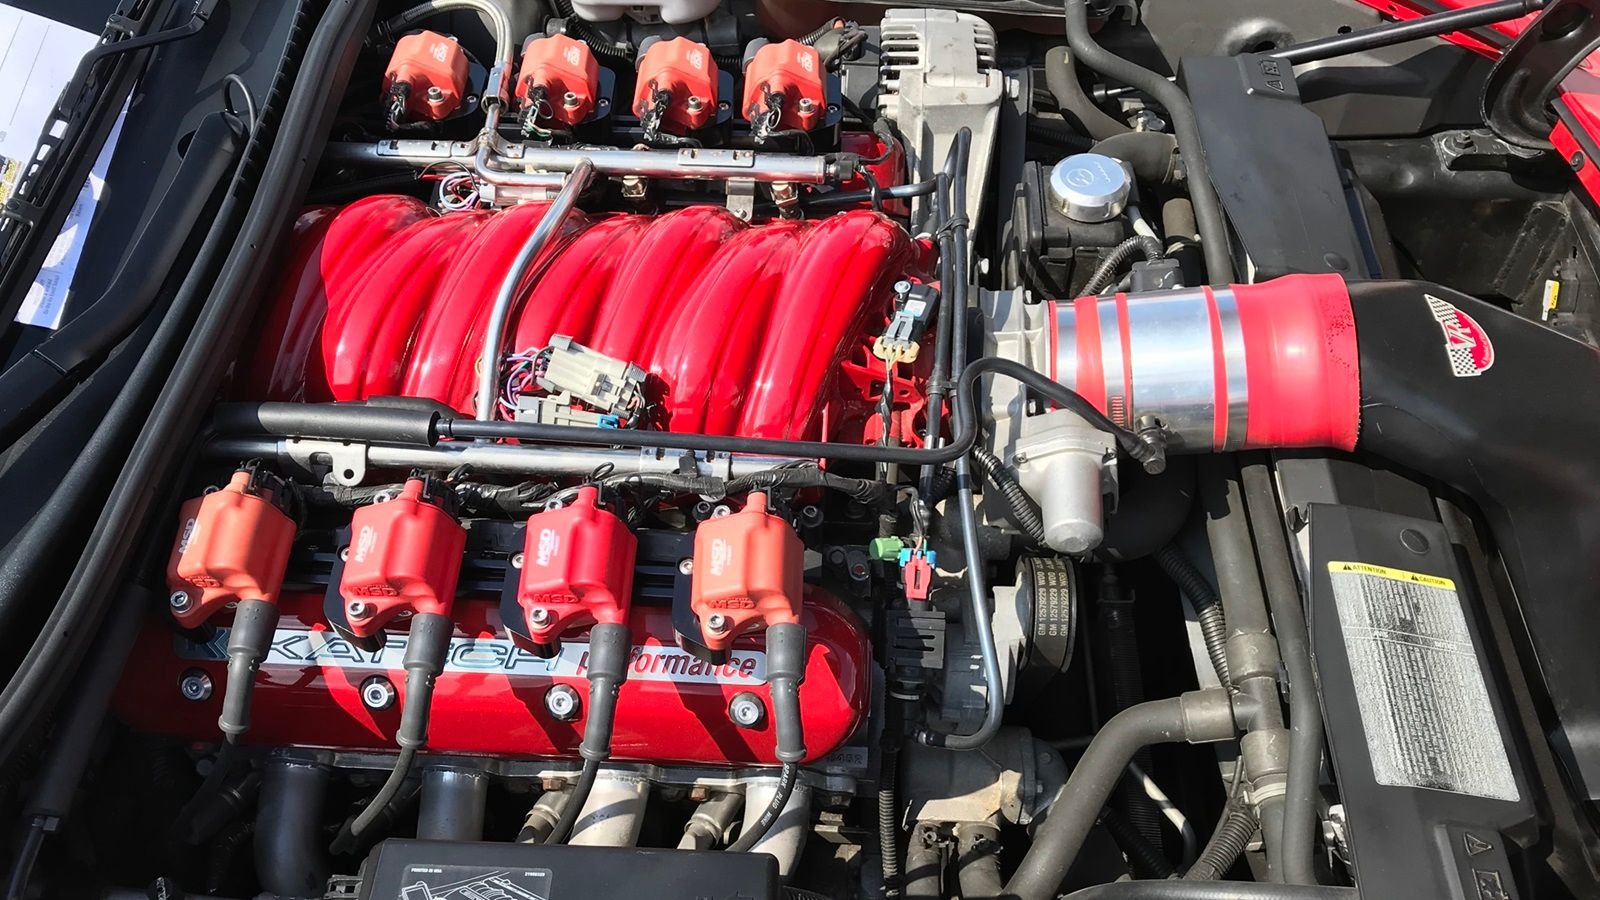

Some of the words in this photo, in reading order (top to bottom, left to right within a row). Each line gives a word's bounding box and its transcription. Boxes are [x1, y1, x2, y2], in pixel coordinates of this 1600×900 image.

[179, 518, 196, 553] MSD
[354, 525, 371, 563] MSD
[536, 528, 552, 566] MSD
[710, 538, 723, 576] MSD
[1352, 564, 1387, 575] ATTENTION
[1418, 575, 1446, 586] CAUTION
[533, 593, 580, 604] MSD
[710, 599, 756, 609] MSD
[1038, 587, 1047, 621] 12579229
[1049, 588, 1058, 621] 12579229
[1038, 623, 1046, 636] GM
[1048, 623, 1057, 637] GM
[781, 763, 790, 788] SPARK
[772, 790, 783, 809] PLUG
